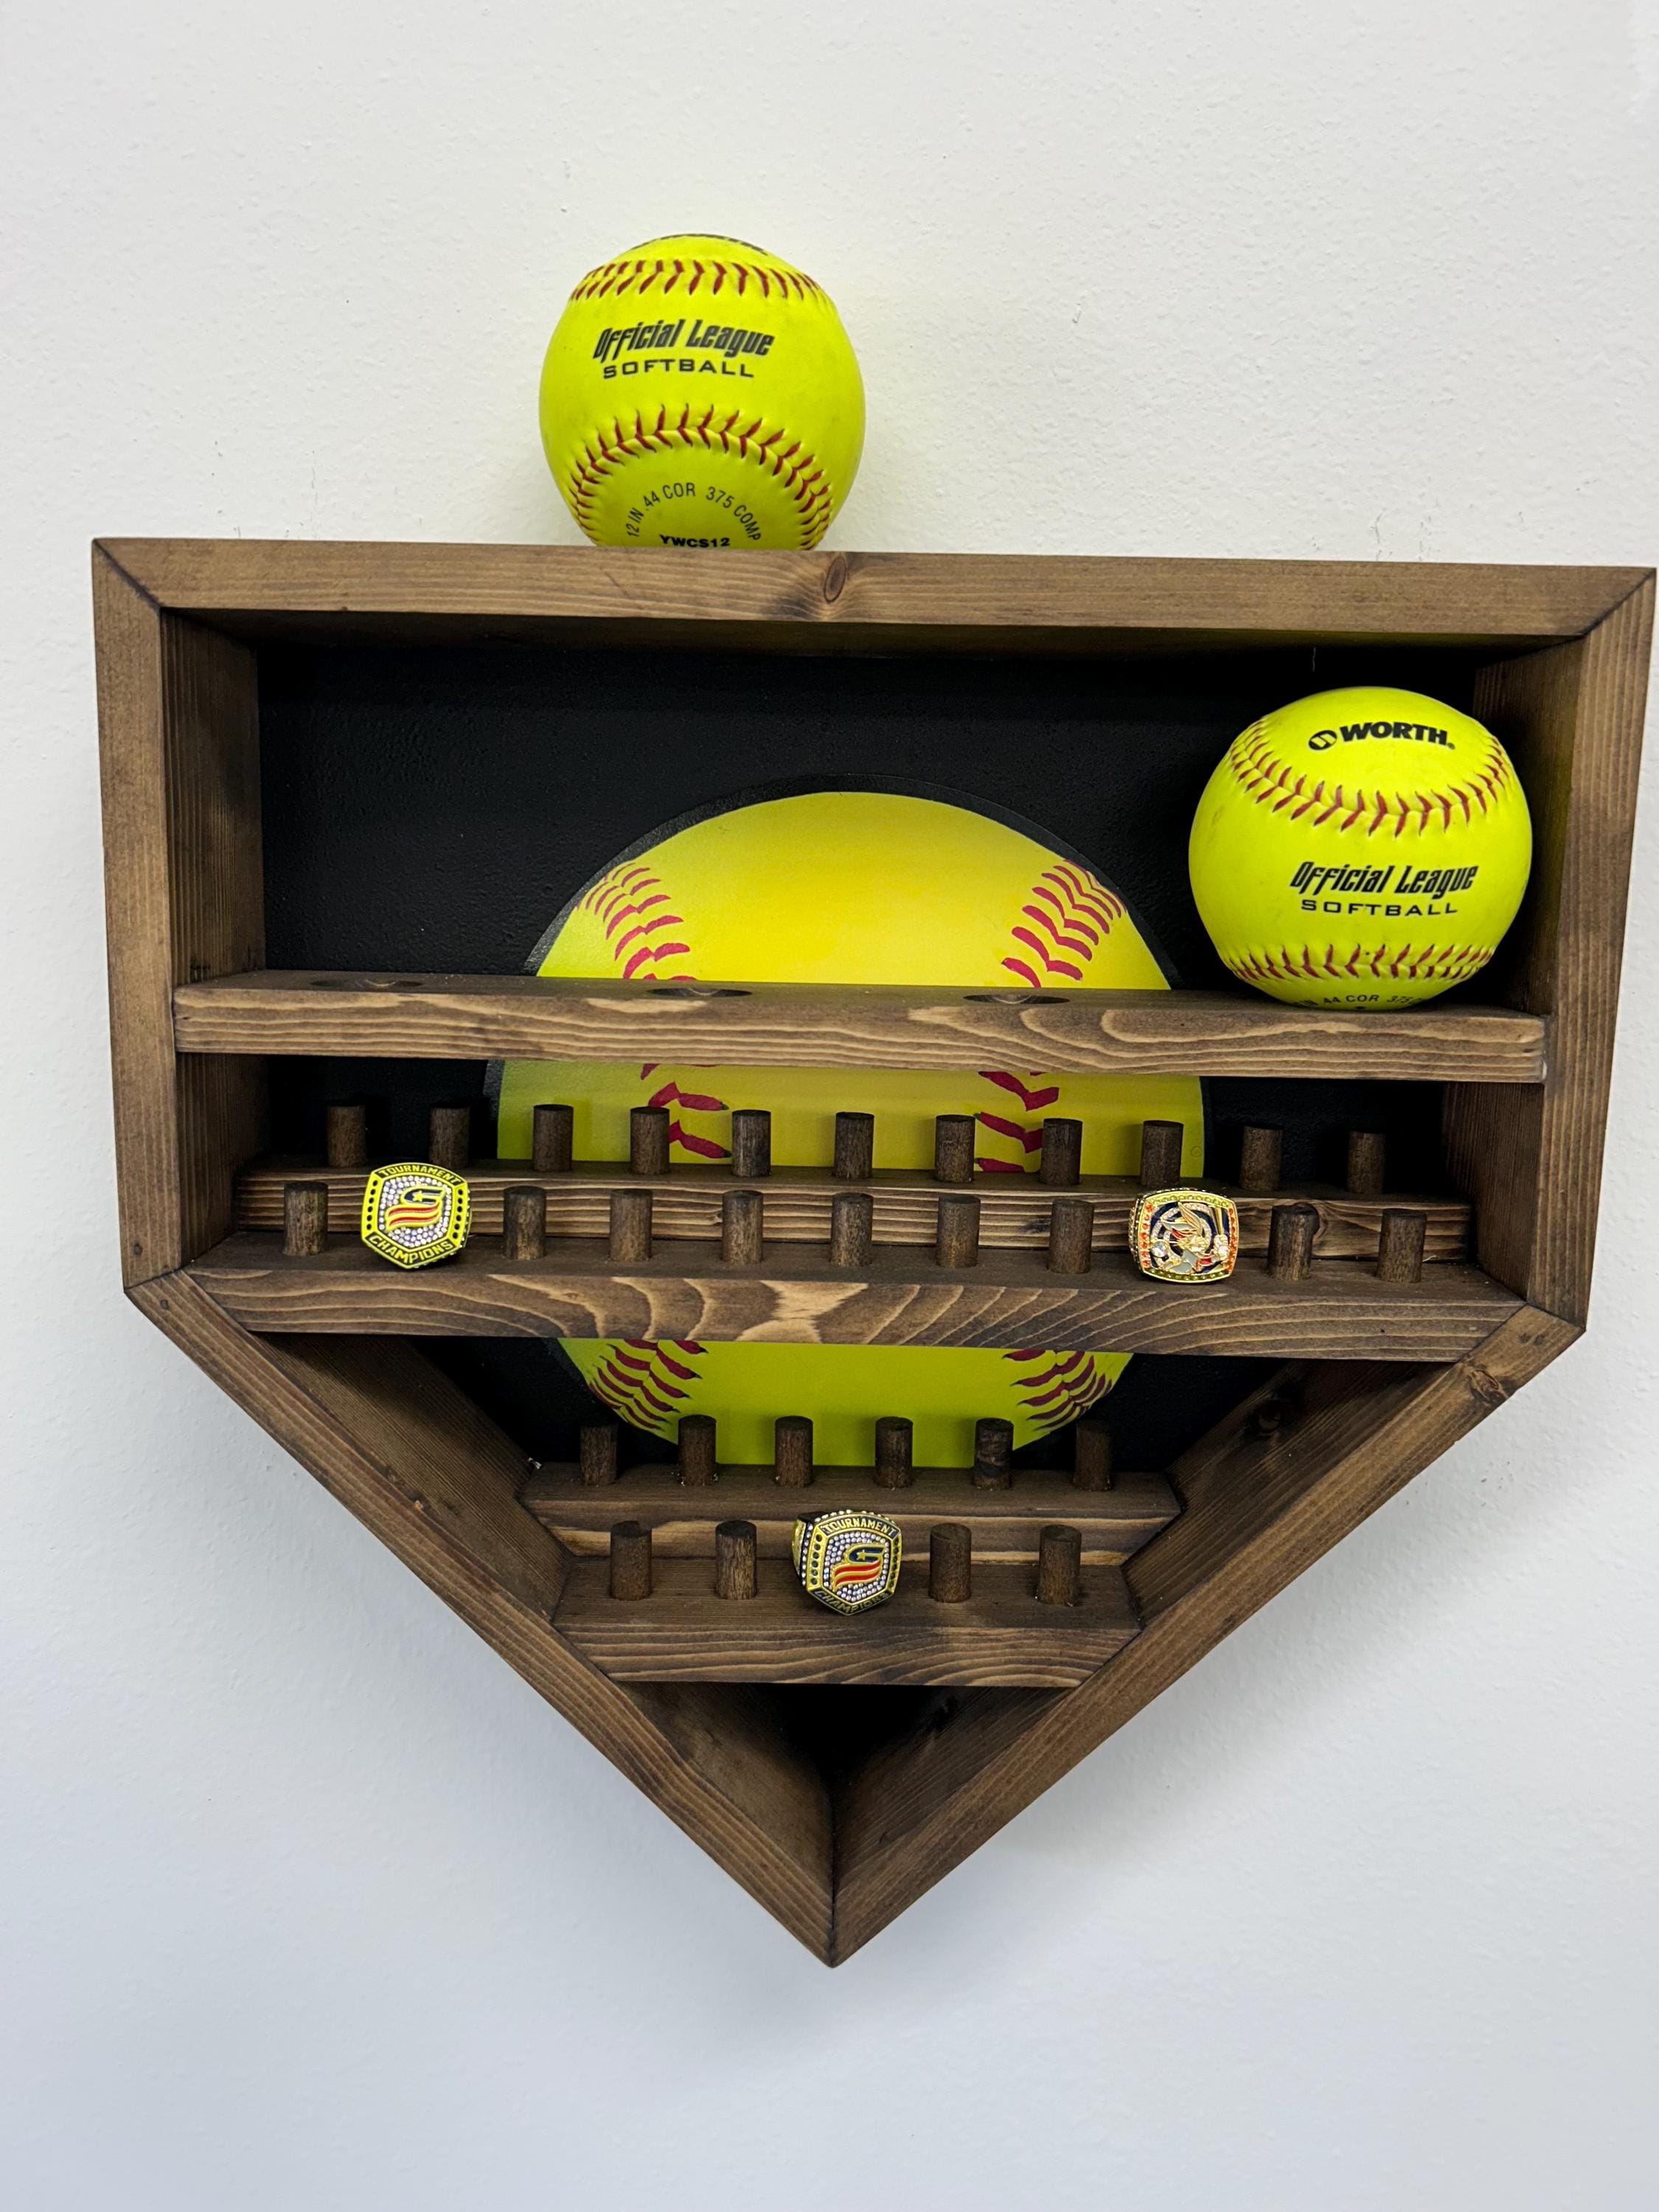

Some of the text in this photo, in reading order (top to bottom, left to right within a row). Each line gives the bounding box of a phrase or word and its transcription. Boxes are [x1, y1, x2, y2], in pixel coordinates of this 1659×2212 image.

[593, 319, 775, 364] Official League
[603, 358, 754, 379] SOFTBALL
[662, 482, 696, 499] COR
[706, 486, 734, 509] 375
[628, 507, 644, 524] IN
[734, 504, 761, 540] COMP
[626, 523, 640, 538] 12
[659, 534, 731, 548] YWCS12
[1290, 861, 1478, 900] Official League
[1301, 900, 1458, 917] SOFTBALL
[1346, 995, 1379, 1003] COR
[378, 1165, 462, 1186] TOURNAMENT
[369, 1235, 454, 1264] CHAMPIONS
[821, 1517, 897, 1536] TOURNAMENT
